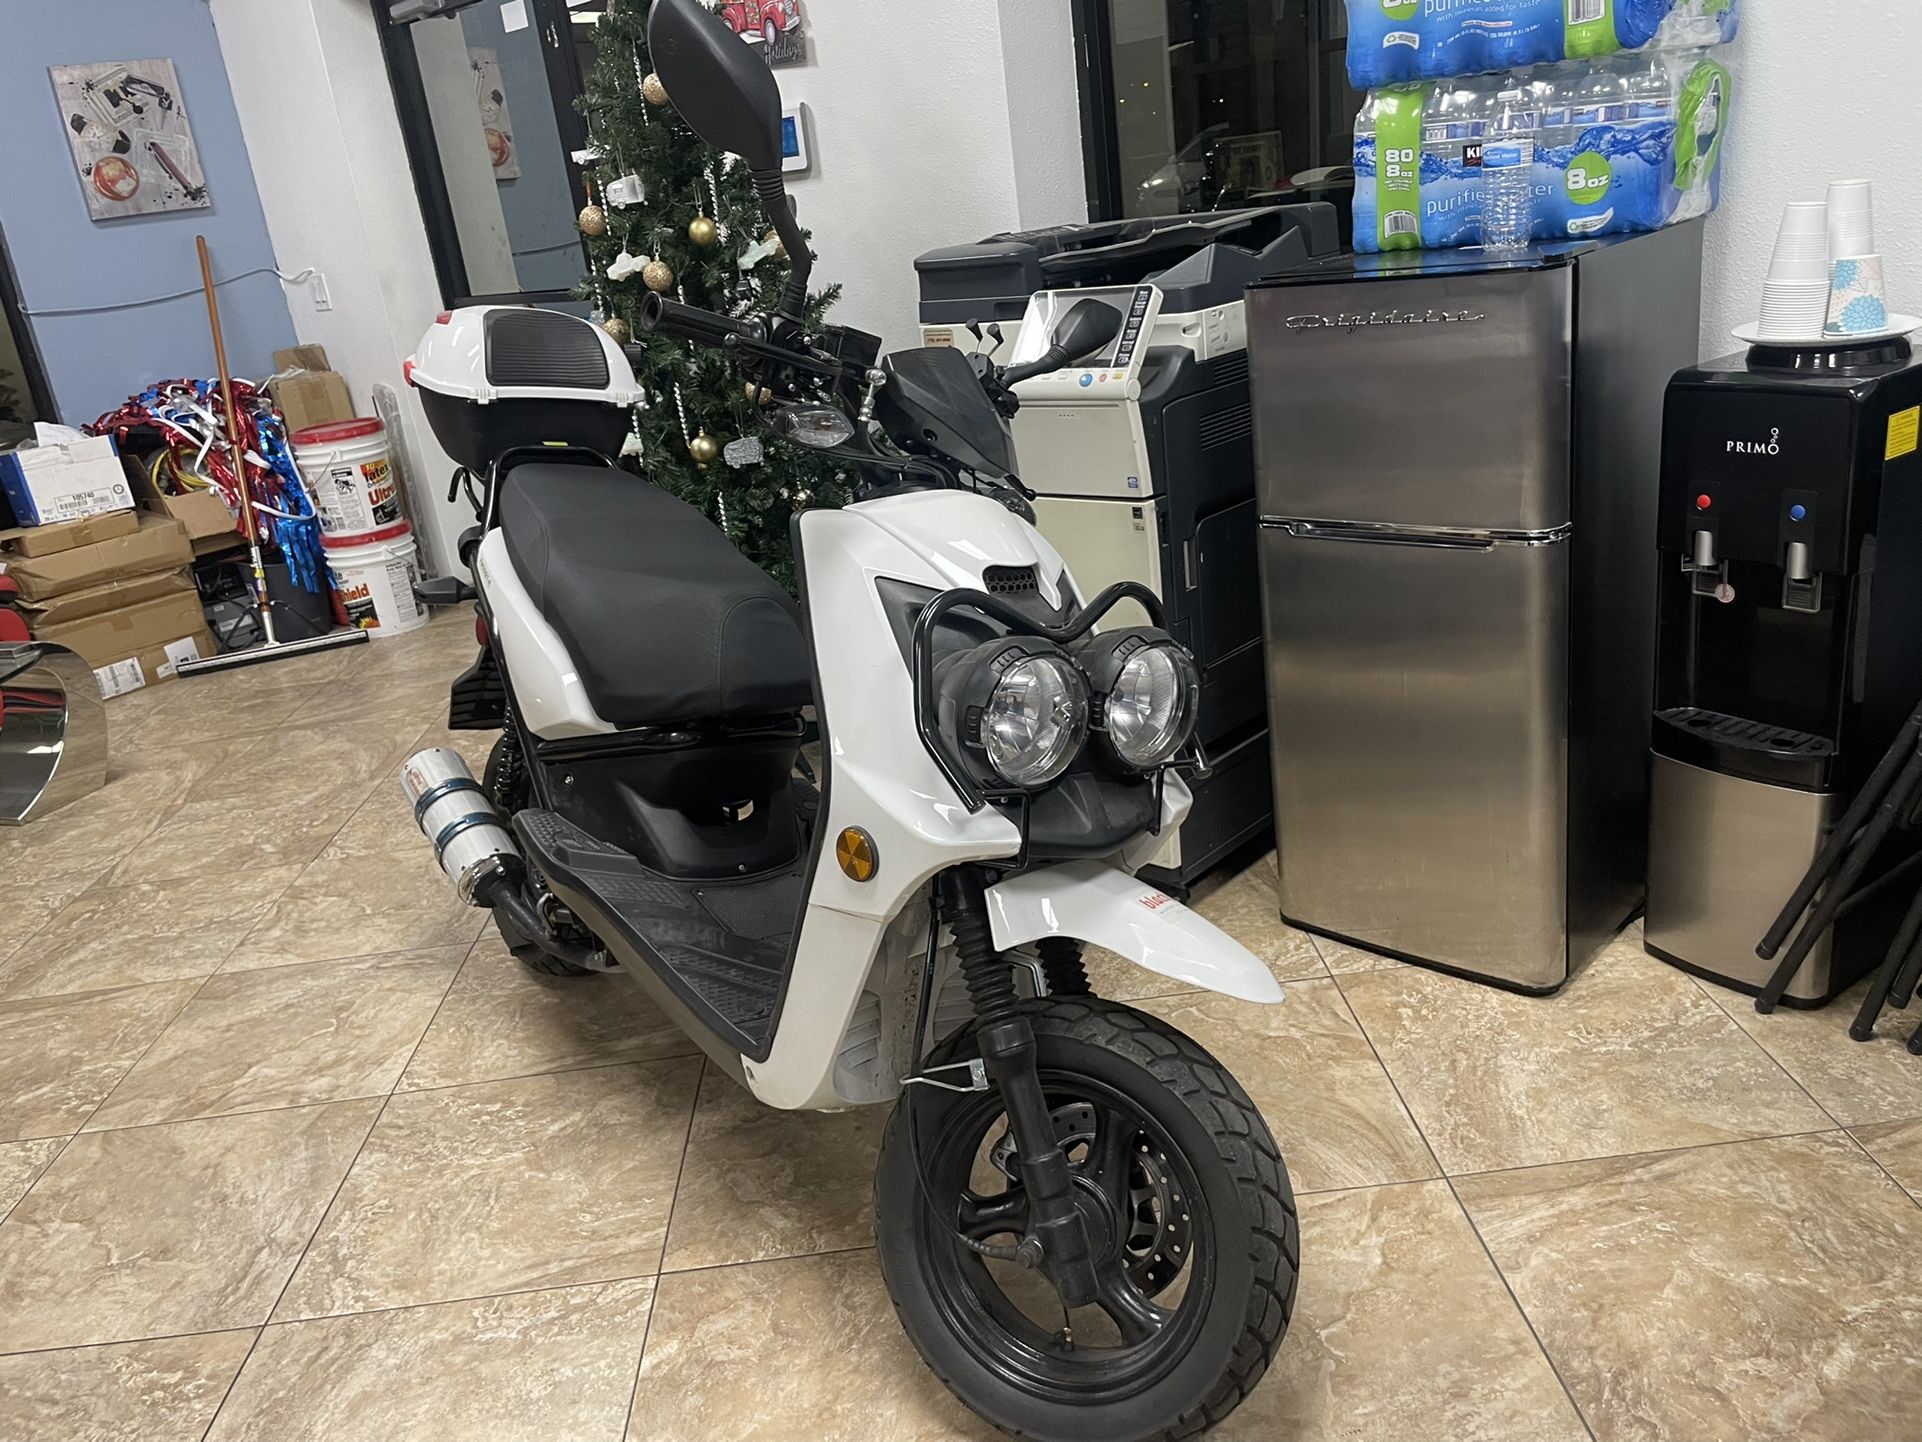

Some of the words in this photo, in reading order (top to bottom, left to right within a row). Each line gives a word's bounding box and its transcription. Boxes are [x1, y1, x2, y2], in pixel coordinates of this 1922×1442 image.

[1385, 149, 1413, 163] 80
[1567, 168, 1609, 190] 8oz
[1726, 439, 1779, 455] PRIMO
